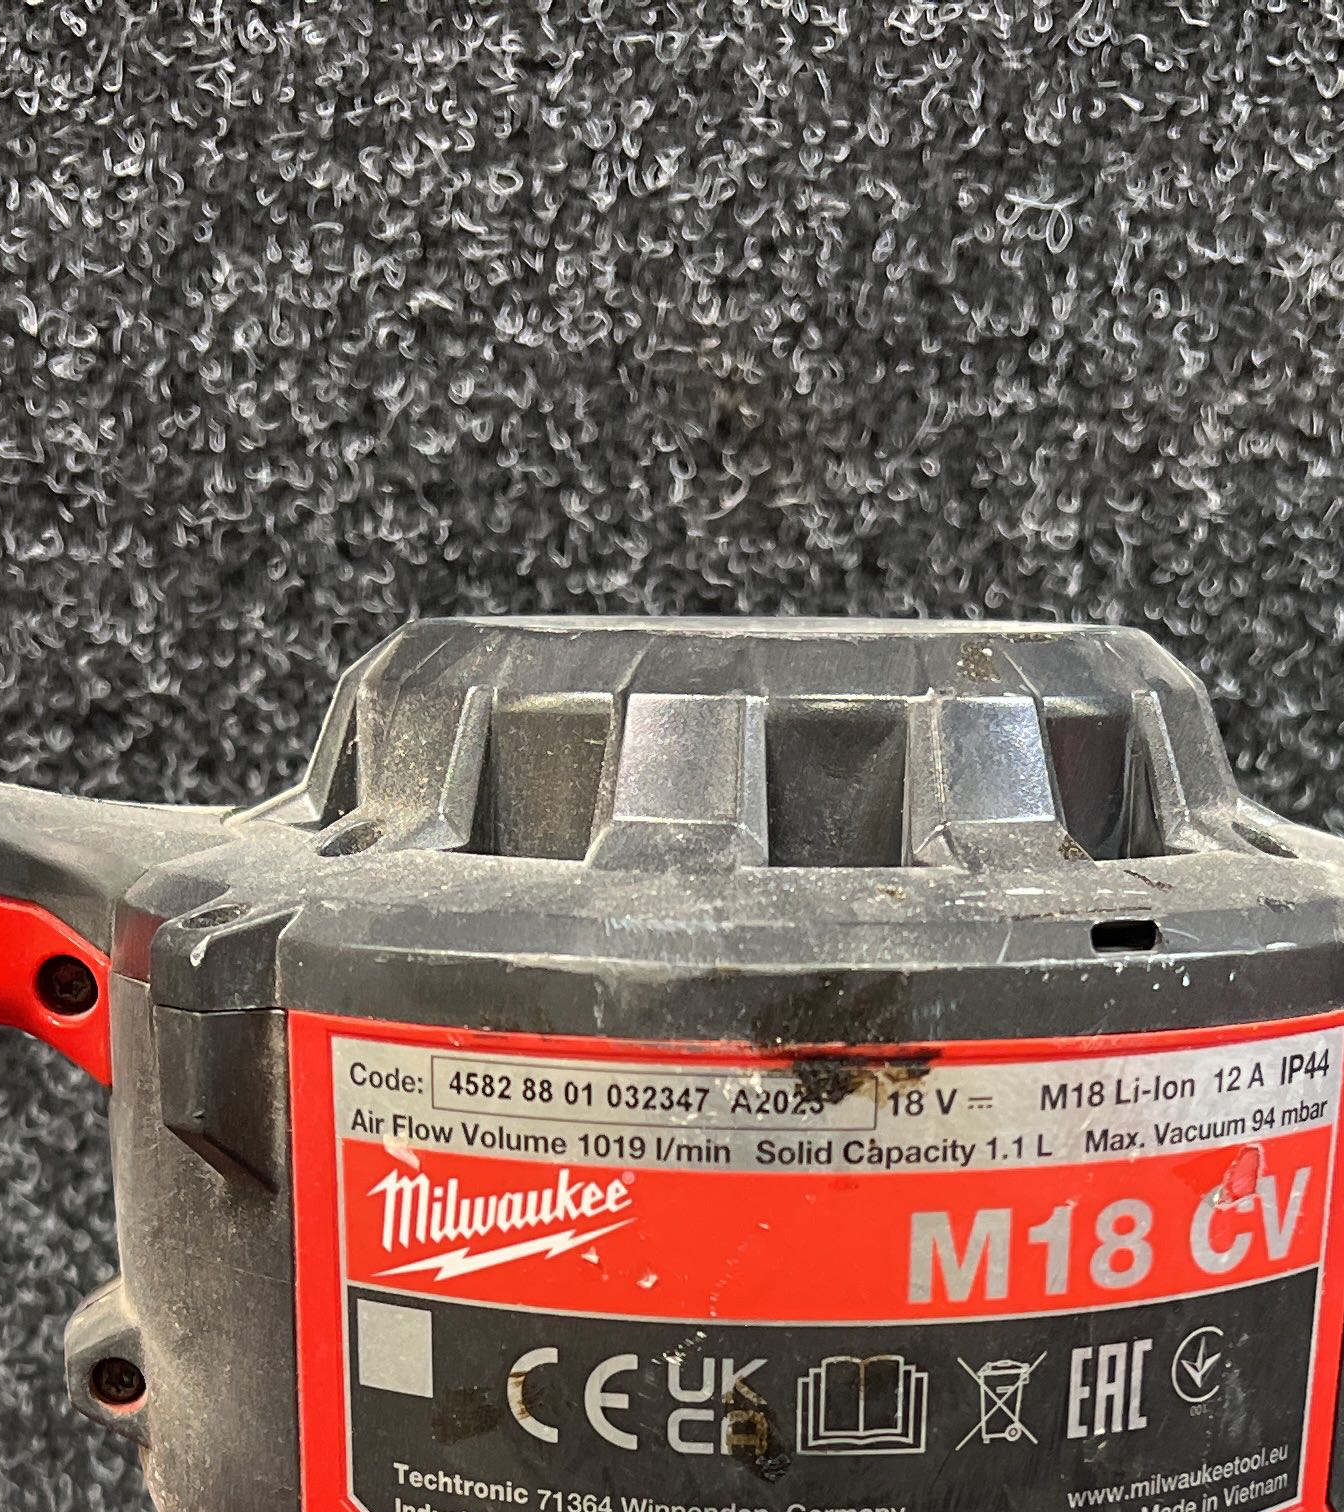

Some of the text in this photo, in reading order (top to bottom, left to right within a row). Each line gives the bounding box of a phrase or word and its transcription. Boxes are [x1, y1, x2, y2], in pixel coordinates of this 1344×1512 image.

[350, 1062, 424, 1094] Code:
[448, 1071, 512, 1100] 4582
[523, 1073, 554, 1103] 88
[565, 1077, 594, 1107] 01
[607, 1083, 710, 1113] 032347
[888, 1048, 1330, 1117] 18 V M18 Li-Ion 12 A IP44
[351, 1099, 1327, 1171] Air Flow Volume 1019 l/min Solid Capacity 1.1 L Max. Vacuum 94 mbar
[366, 1168, 632, 1252] Milwaukee
[907, 1166, 1313, 1306] M18 CV
[393, 1462, 529, 1505] Techtronic
[1068, 1444, 1288, 1508] www.milwaukeetool.eu
[1224, 1472, 1288, 1507] Vietnam
